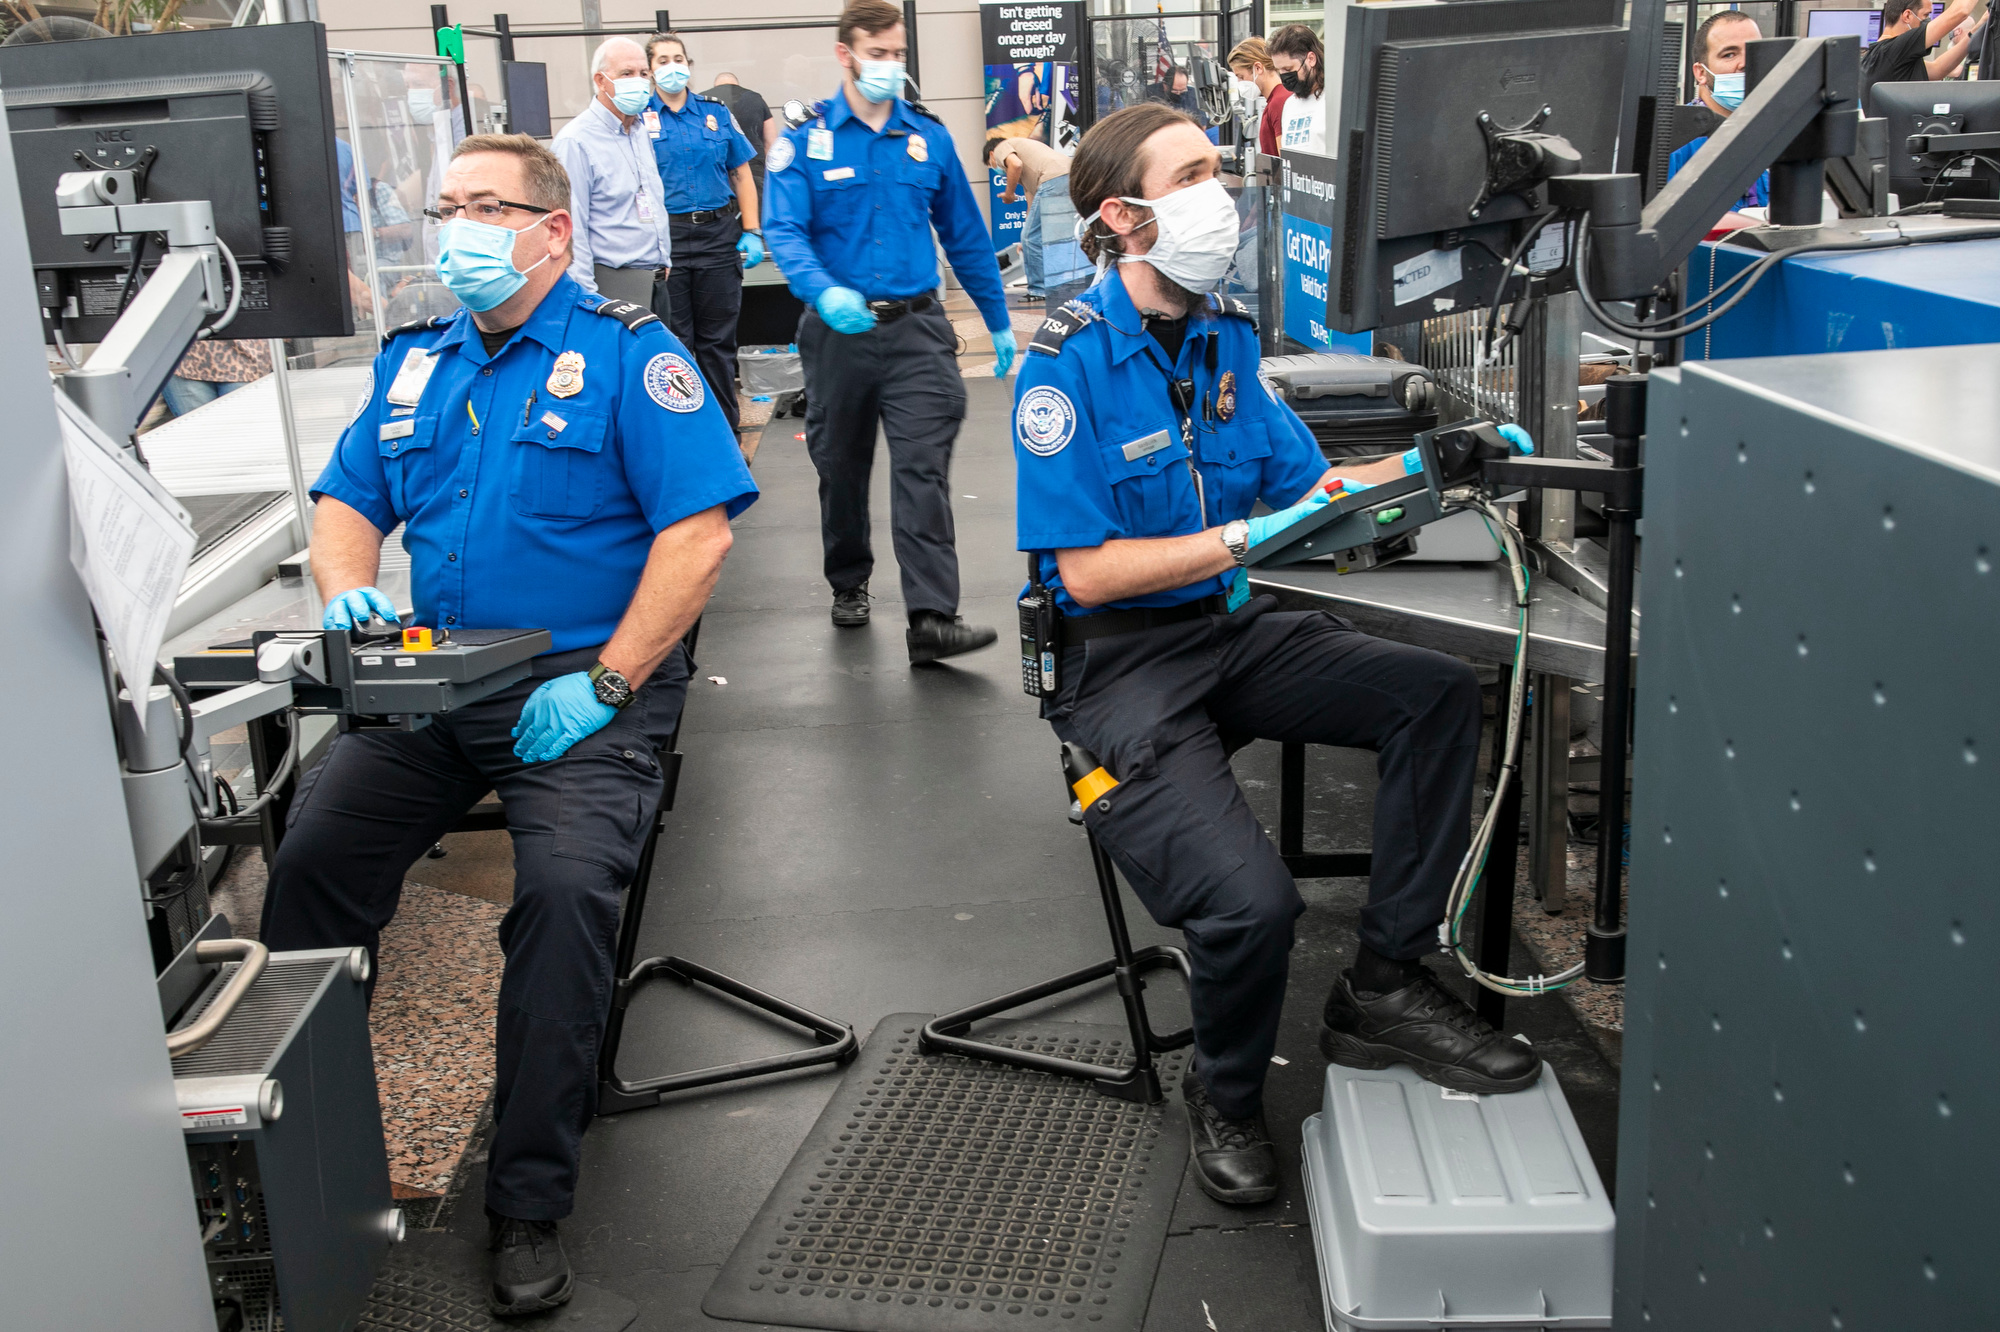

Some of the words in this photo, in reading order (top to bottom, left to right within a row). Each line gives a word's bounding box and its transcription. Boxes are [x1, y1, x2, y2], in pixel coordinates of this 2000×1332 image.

[1000, 7, 1023, 19] Isn't
[1024, 5, 1063, 20] getting
[1010, 19, 1053, 32] dressed
[997, 34, 1025, 45] once
[1025, 33, 1044, 46] per
[1045, 31, 1066, 45] day
[1009, 45, 1056, 59] enough?
[95, 129, 133, 143] NEC
[1291, 171, 1306, 193] Want
[1311, 175, 1325, 200] keep
[1004, 211, 1021, 220] Only
[998, 221, 1012, 230] and
[1013, 221, 1022, 229] 10
[1287, 228, 1301, 262] Get
[1300, 233, 1318, 270] TSA
[1319, 240, 1332, 273] Pr
[1300, 273, 1314, 296] Valid
[1313, 278, 1322, 300] for
[612, 302, 643, 315] TSA
[1042, 317, 1069, 336] TSA
[1309, 319, 1319, 340] TSA
